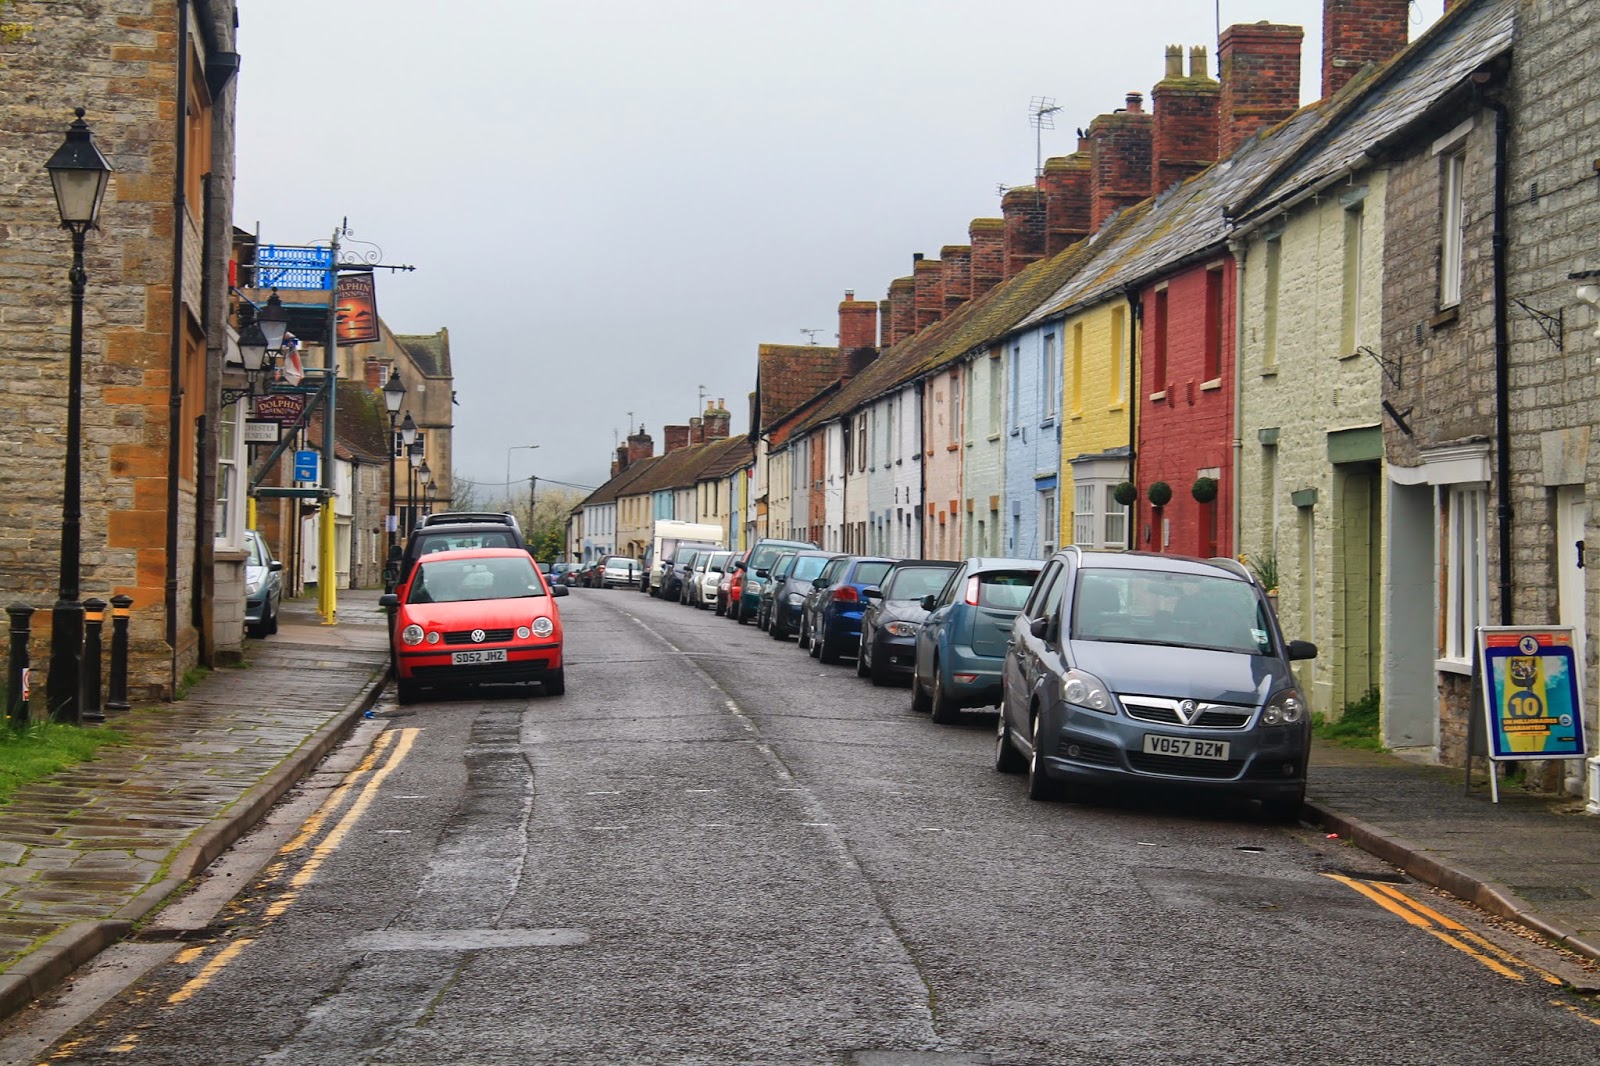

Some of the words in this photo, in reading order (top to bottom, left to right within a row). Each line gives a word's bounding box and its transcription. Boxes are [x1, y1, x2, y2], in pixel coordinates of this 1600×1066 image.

[259, 400, 302, 411] DOLPHIN
[456, 652, 482, 663] SD52
[484, 651, 504, 661] JHZ
[1511, 697, 1538, 716] 10
[1151, 737, 1190, 756] VO57
[1194, 742, 1224, 758] BZW
